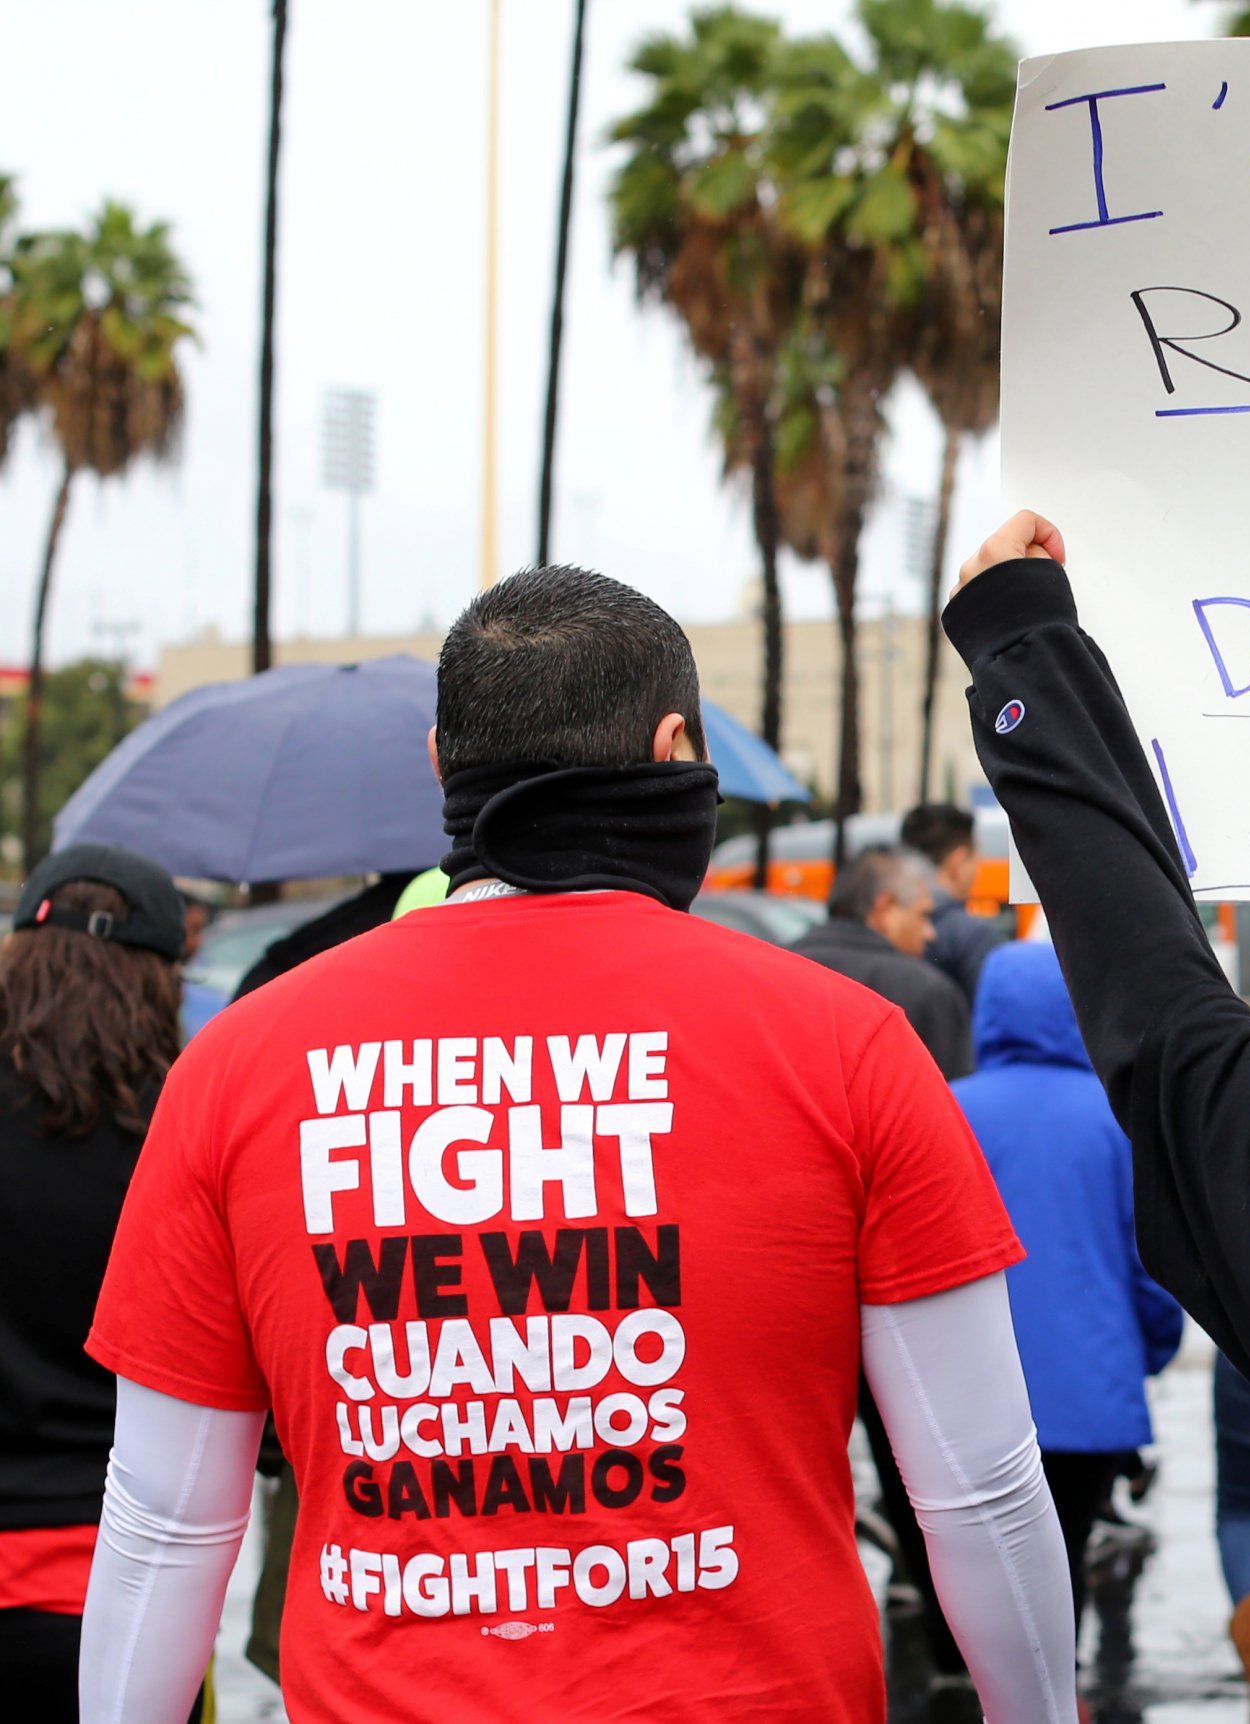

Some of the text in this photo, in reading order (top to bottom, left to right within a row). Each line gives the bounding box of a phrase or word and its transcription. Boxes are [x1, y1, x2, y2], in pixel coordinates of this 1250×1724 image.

[306, 1031, 669, 1114] WHEN WE
[299, 1102, 674, 1235] FIGHT
[311, 1224, 681, 1323] WE WIN
[325, 1308, 686, 1401] CUANDO
[336, 1388, 687, 1461] LUCHAMOS
[343, 1445, 686, 1520] GANAMOS
[320, 1525, 739, 1617] #FIGHTFOR15
